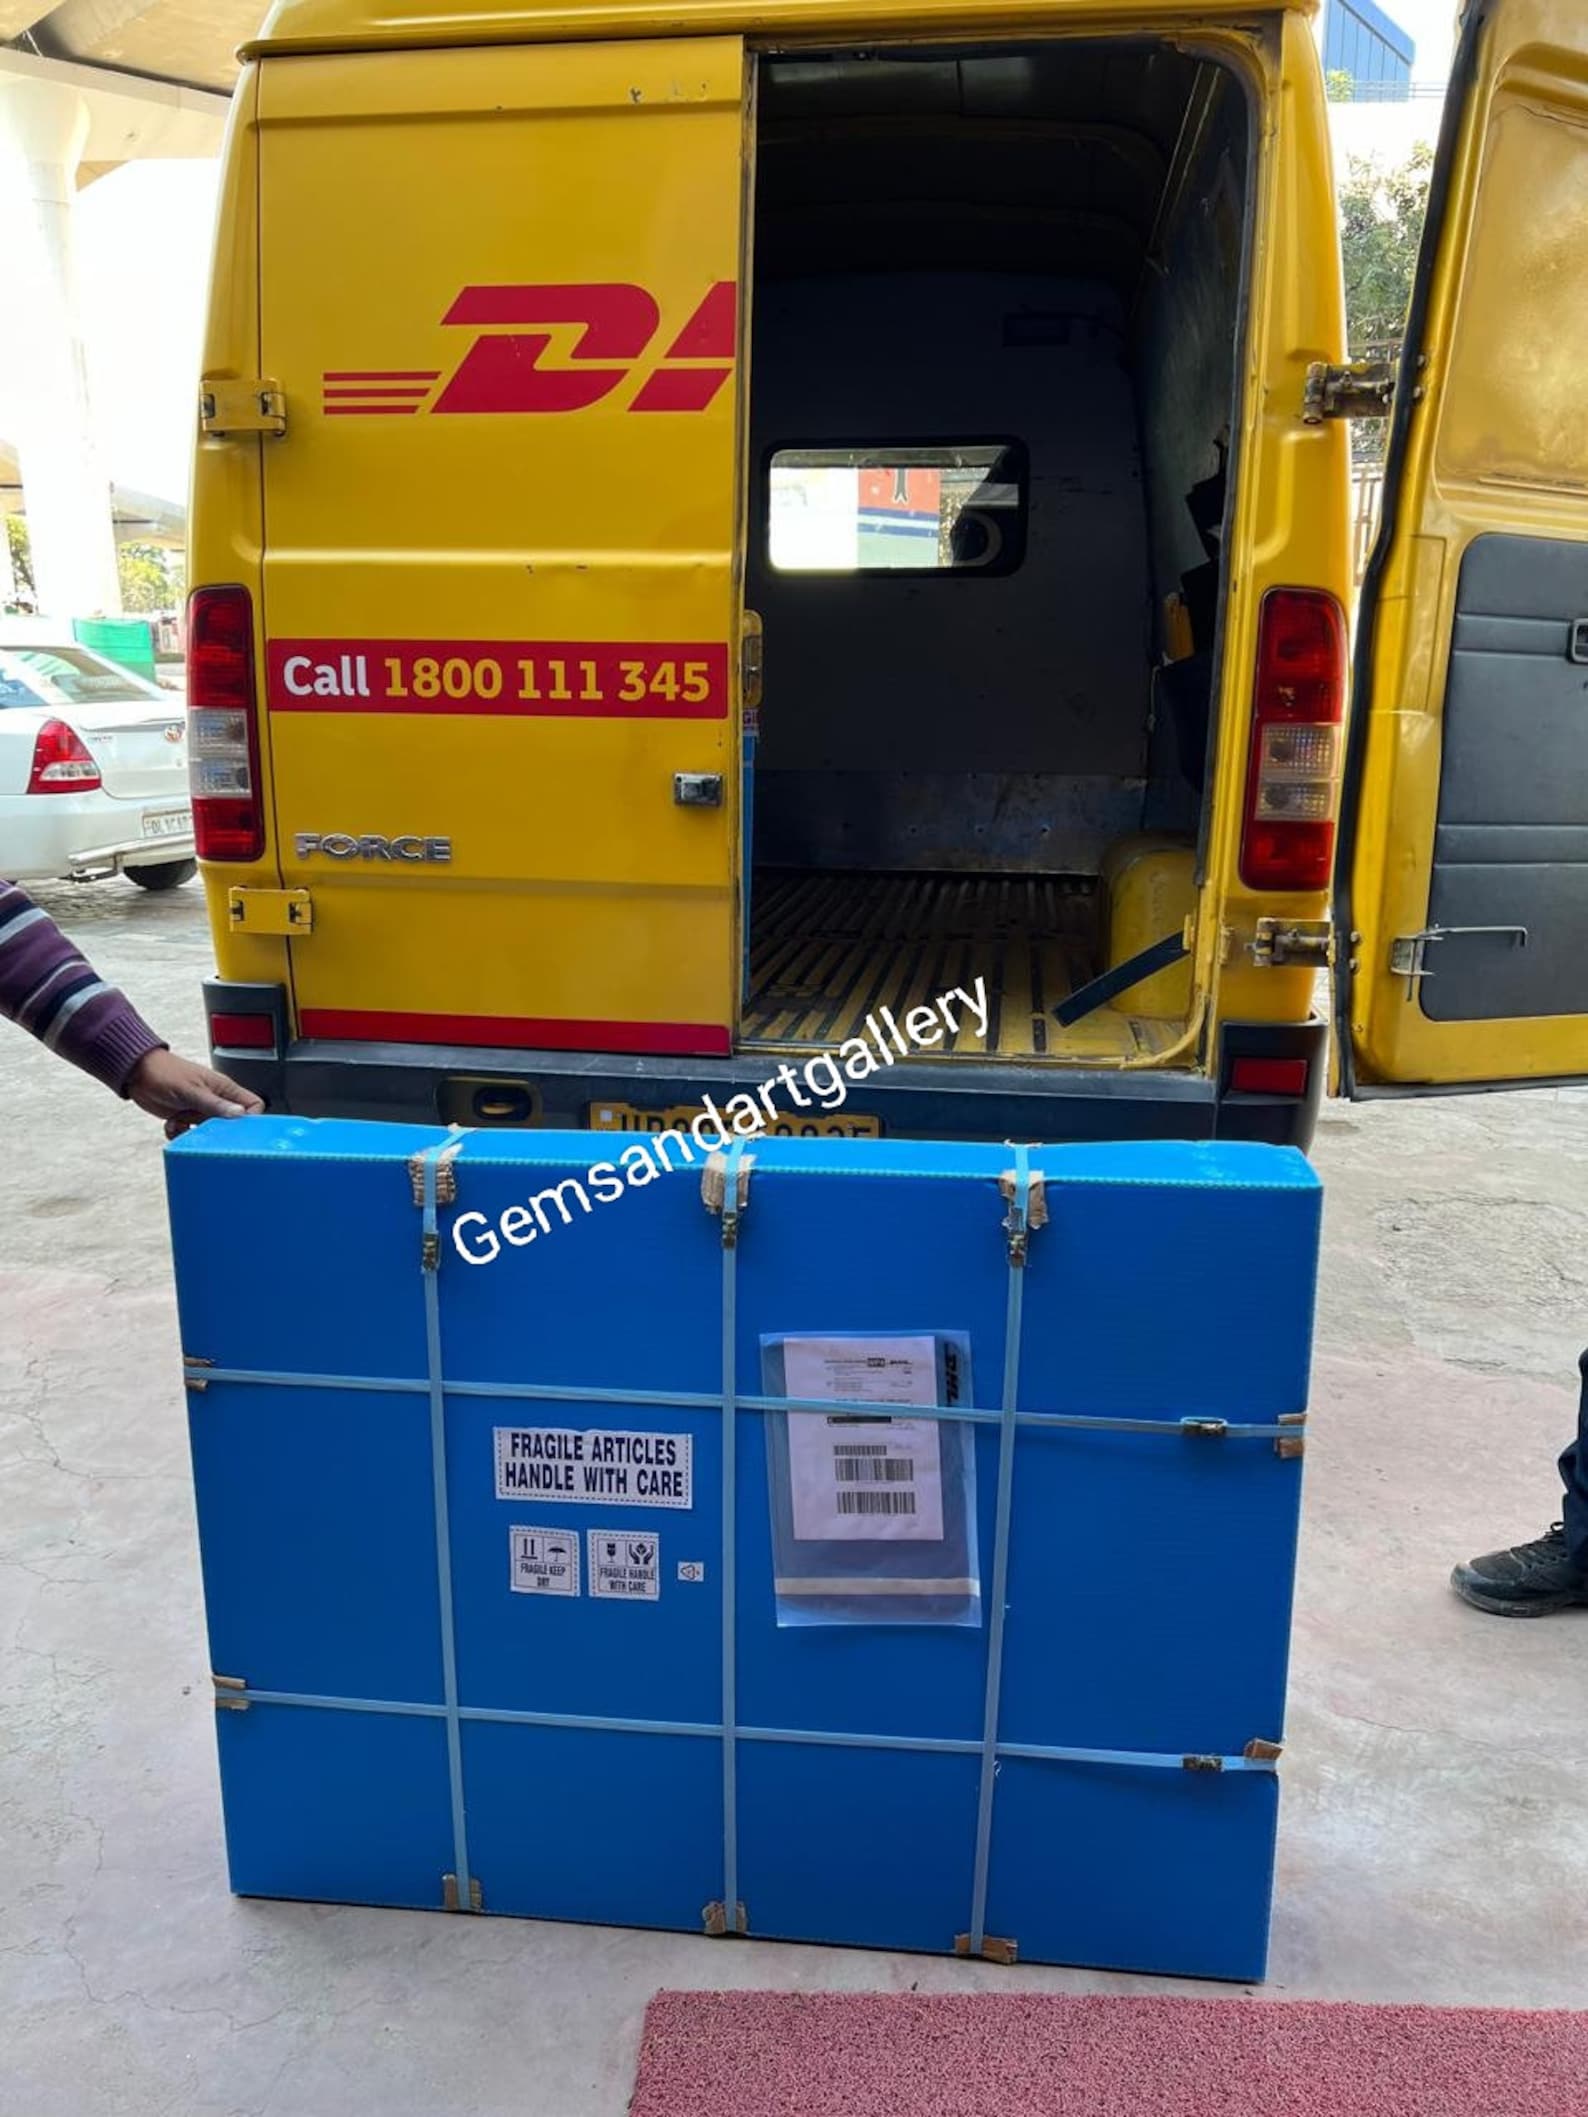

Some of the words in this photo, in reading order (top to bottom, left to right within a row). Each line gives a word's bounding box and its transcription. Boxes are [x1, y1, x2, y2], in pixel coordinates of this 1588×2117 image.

[282, 655, 371, 698] Call
[384, 657, 503, 700] 1800
[517, 659, 604, 701] 111
[616, 661, 711, 703] 345
[293, 832, 452, 864] FORCE
[510, 1432, 585, 1461] FRAGILE
[591, 1435, 677, 1466] ARTICLES
[505, 1461, 575, 1491] HANDLE
[583, 1466, 628, 1494] WITH
[636, 1469, 684, 1497] CARE
[520, 1562, 548, 1575] FRAGILE
[549, 1565, 567, 1577] KEEP
[600, 1567, 627, 1579] FRAGILE
[628, 1568, 656, 1580] HANDLE
[536, 1576, 550, 1587] DRY
[608, 1579, 626, 1591] WITH
[628, 1580, 647, 1592] CARE
